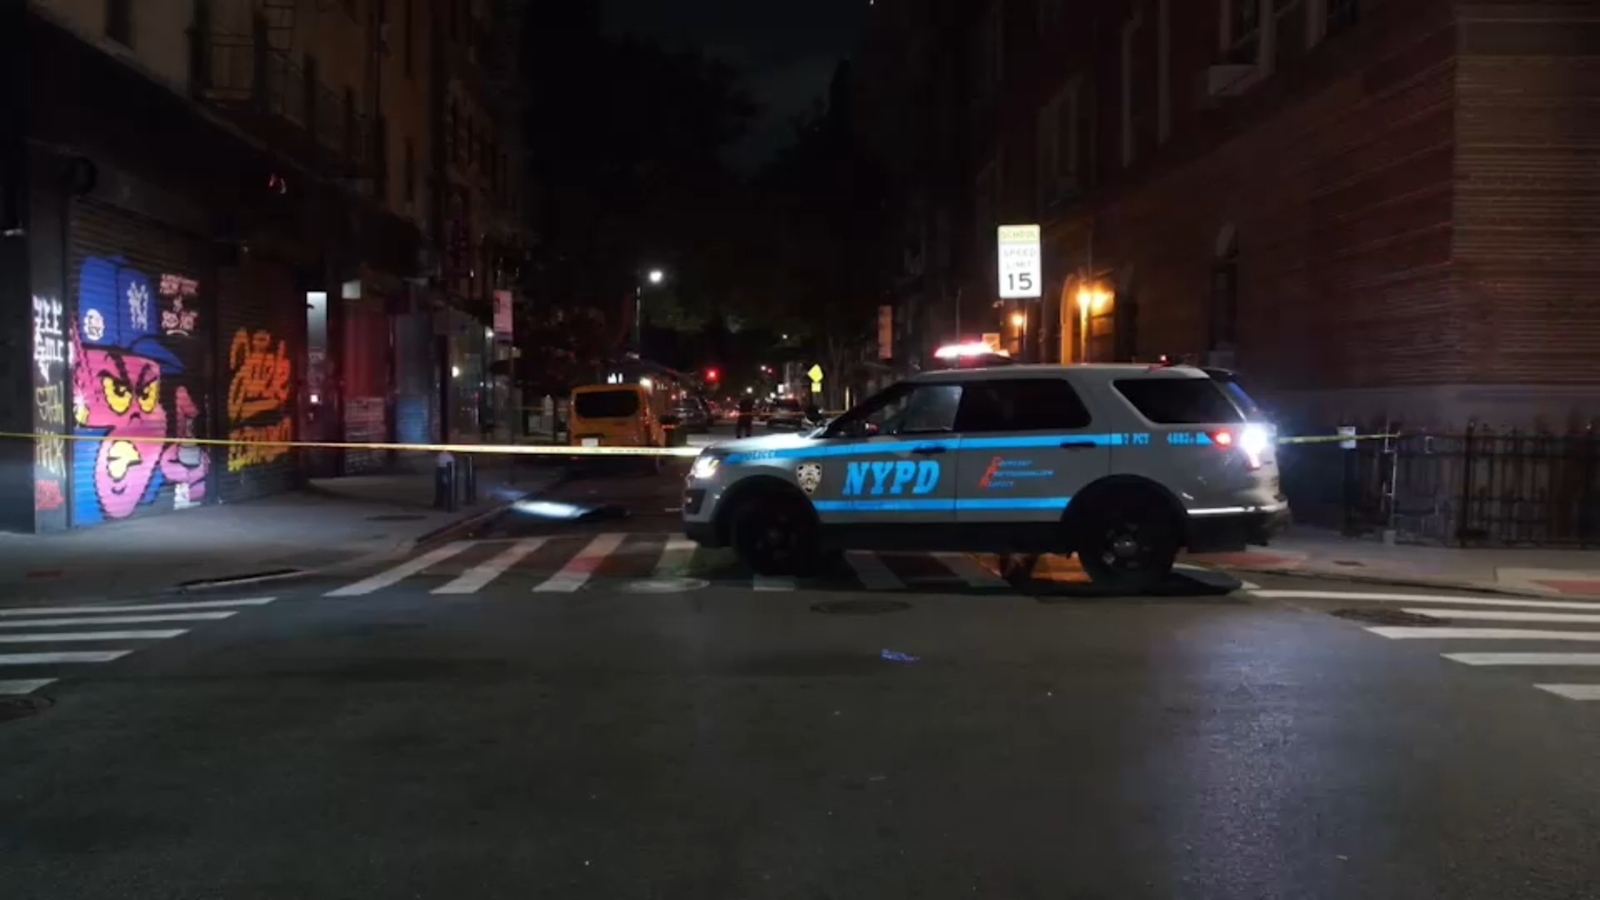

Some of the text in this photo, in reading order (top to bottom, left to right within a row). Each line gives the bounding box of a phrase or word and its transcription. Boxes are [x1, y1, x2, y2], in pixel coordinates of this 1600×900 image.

[1003, 248, 1036, 258] SPEED
[1007, 272, 1033, 291] 15
[842, 460, 941, 496] NYPD
